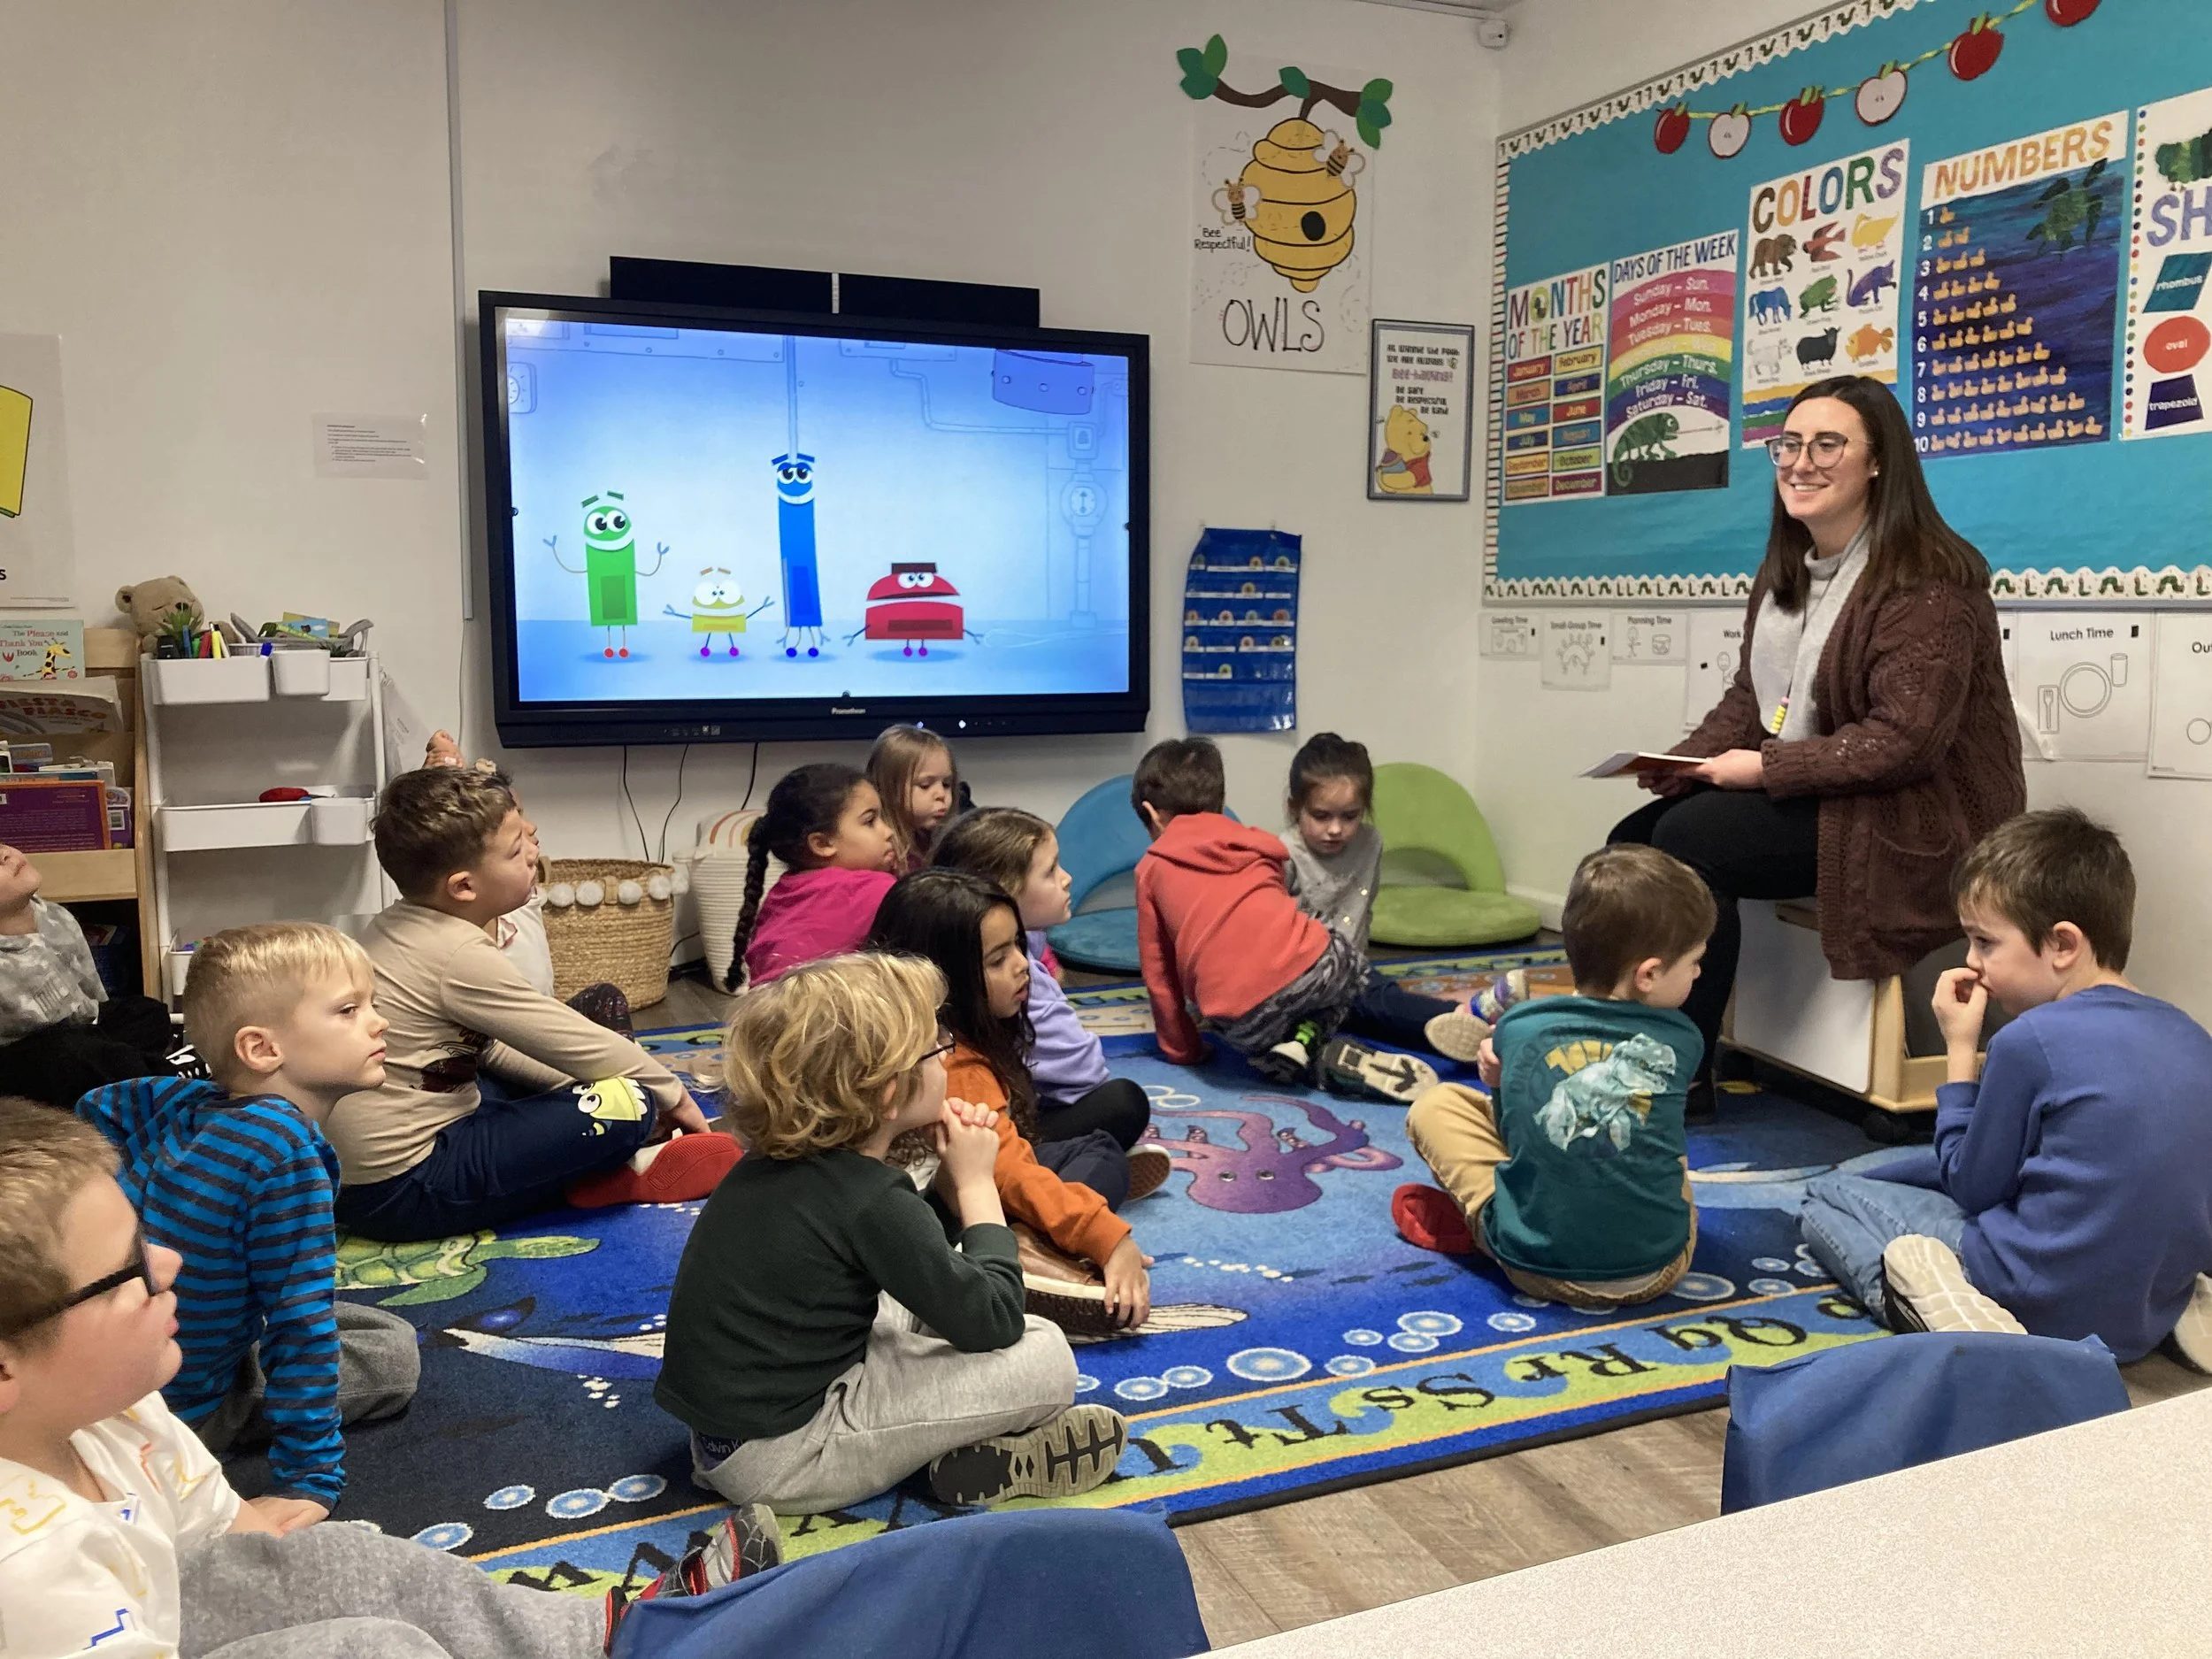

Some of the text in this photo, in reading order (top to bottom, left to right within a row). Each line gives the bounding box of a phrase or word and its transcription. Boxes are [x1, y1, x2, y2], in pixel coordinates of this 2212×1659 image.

[1934, 120, 2113, 199] NUMBERS
[1753, 148, 1904, 234] COLORS
[1927, 209, 1934, 225] 1
[2147, 186, 2212, 247] SH
[1194, 236, 1251, 253] Respectful!
[1923, 234, 1932, 251] 2
[1614, 234, 1736, 283] DAYS OF THE WEEK
[1920, 260, 1931, 277] 3
[2155, 274, 2203, 291] rhombus
[1509, 269, 1605, 329] MONTHS
[1633, 283, 1672, 306] Sunday
[1918, 285, 1929, 301] 4
[1629, 303, 1672, 327] Monday
[1918, 311, 1927, 327] 5
[1222, 296, 1325, 352] OWLS
[1508, 312, 1603, 359] OF THE YEAR
[1628, 322, 1672, 346] Tuesday
[1917, 336, 1927, 353] 6
[2165, 339, 2188, 350] oval
[1620, 359, 1671, 388] Thursday
[1917, 361, 1926, 378] 7
[1635, 378, 1669, 398] Friday
[1917, 387, 1926, 403] 8
[1626, 394, 1674, 419] Saturday
[2148, 397, 2198, 411] trapezoid
[1917, 411, 1925, 427] 9
[1914, 435, 1929, 452] 10
[2050, 627, 2114, 641] Lunch Time
[2192, 641, 2212, 653] Ou
